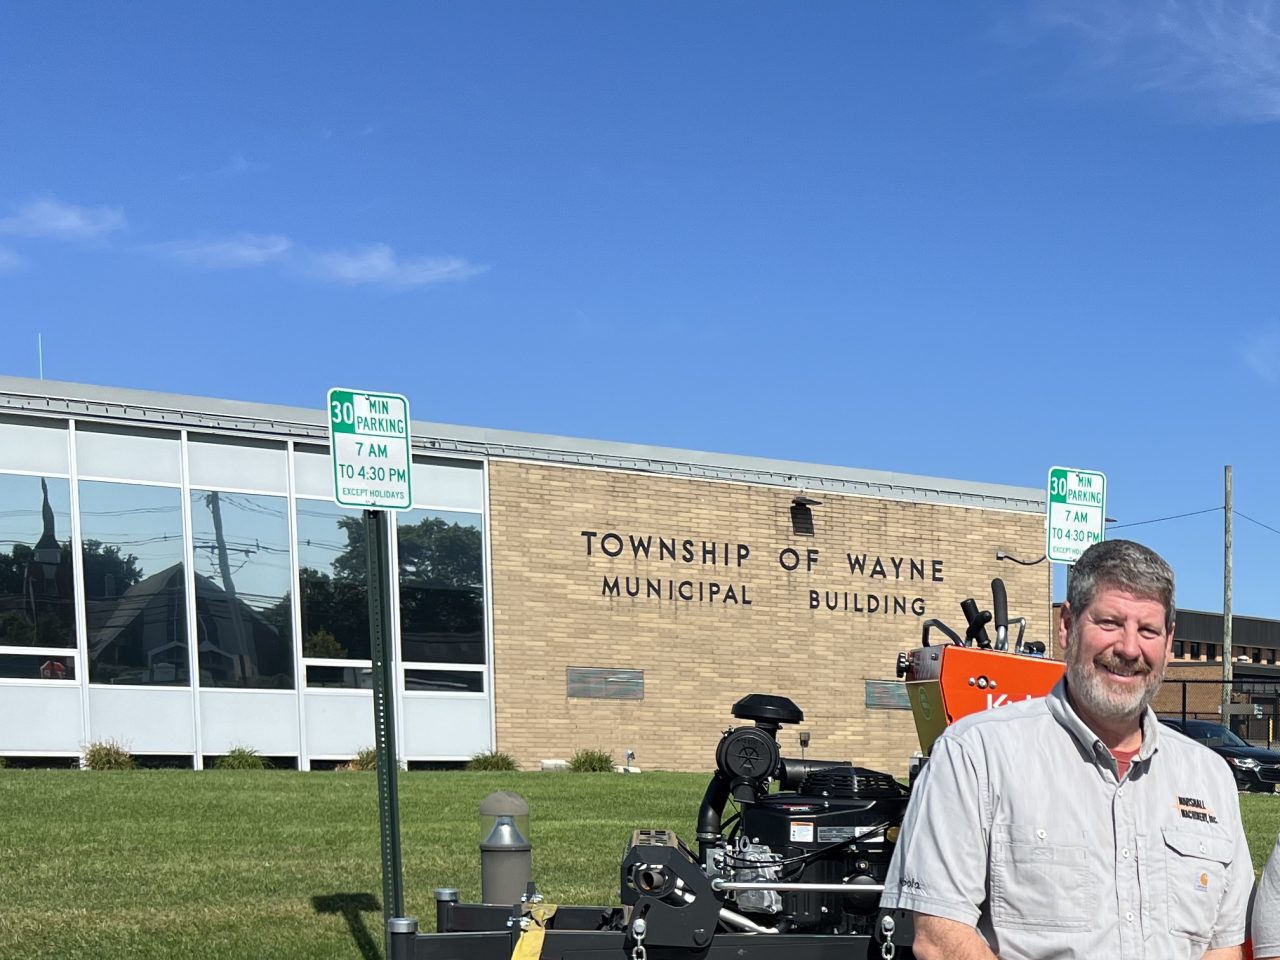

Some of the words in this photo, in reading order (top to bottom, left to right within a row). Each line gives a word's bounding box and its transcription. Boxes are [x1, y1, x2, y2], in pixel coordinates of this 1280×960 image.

[331, 401, 354, 424] 30
[369, 400, 389, 414] MIN
[357, 416, 404, 434] PARKING
[355, 442, 364, 456] 7
[368, 444, 388, 458] AM
[339, 464, 354, 478] TO
[358, 466, 385, 481] 4:30
[389, 468, 406, 483] PM
[1050, 477, 1066, 496] 30
[1078, 477, 1092, 488] MIN
[343, 487, 368, 497] EXCEPT
[370, 489, 404, 499] HOLIDAYS
[1068, 489, 1101, 504] PARKING
[1065, 510, 1071, 521] 7
[1074, 511, 1088, 523] AM
[1052, 528, 1062, 539] TO
[1087, 531, 1100, 542] PM
[581, 531, 751, 567] TOWNSHIP
[779, 547, 820, 571] OF
[847, 552, 944, 582] WAYNE
[601, 575, 752, 605] MUNICIPAL
[809, 590, 926, 616] BUILDING
